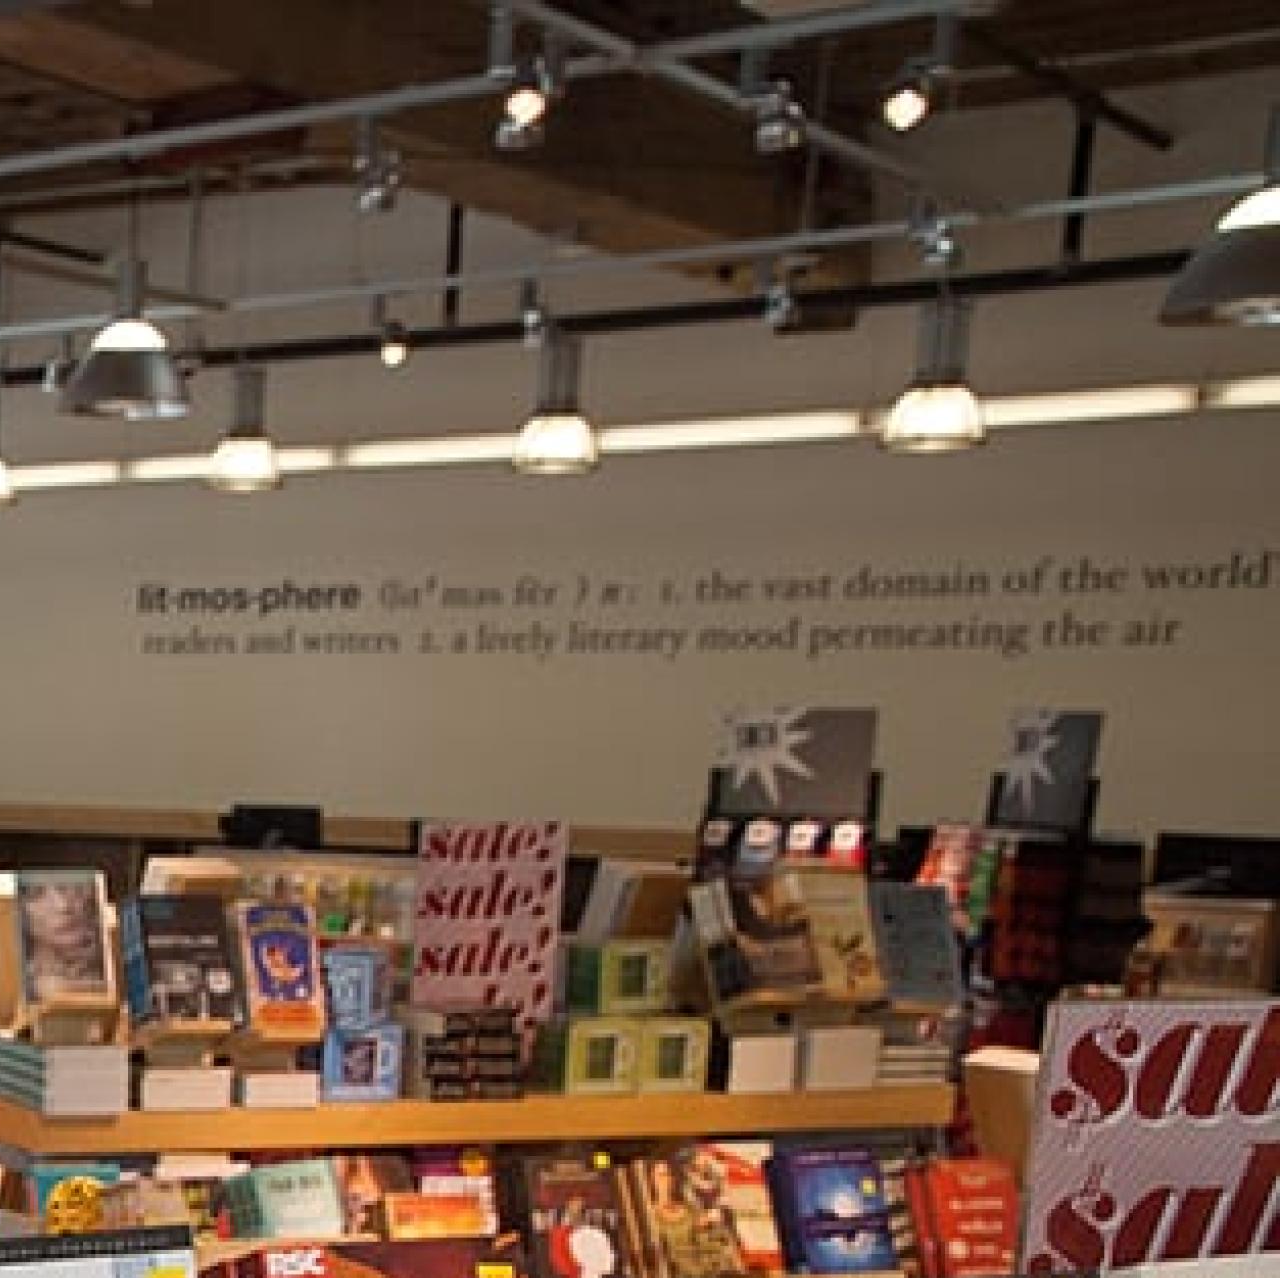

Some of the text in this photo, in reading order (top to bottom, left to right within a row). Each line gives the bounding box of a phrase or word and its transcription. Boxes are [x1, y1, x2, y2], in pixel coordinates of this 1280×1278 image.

[695, 569, 753, 605] the
[761, 574, 833, 600] vast
[842, 564, 991, 598] domain
[1000, 555, 1055, 593] of
[1059, 556, 1130, 593] the
[142, 624, 238, 653] readers
[243, 625, 297, 653] and
[301, 629, 398, 653] writers
[475, 624, 560, 663] lively
[568, 620, 688, 663] literary
[699, 615, 800, 650] mood
[806, 612, 1032, 661] permeating
[1042, 608, 1113, 647] the
[1124, 610, 1185, 646] air
[421, 821, 561, 863] sale!
[416, 868, 557, 919] sale!
[414, 924, 553, 977] sale!
